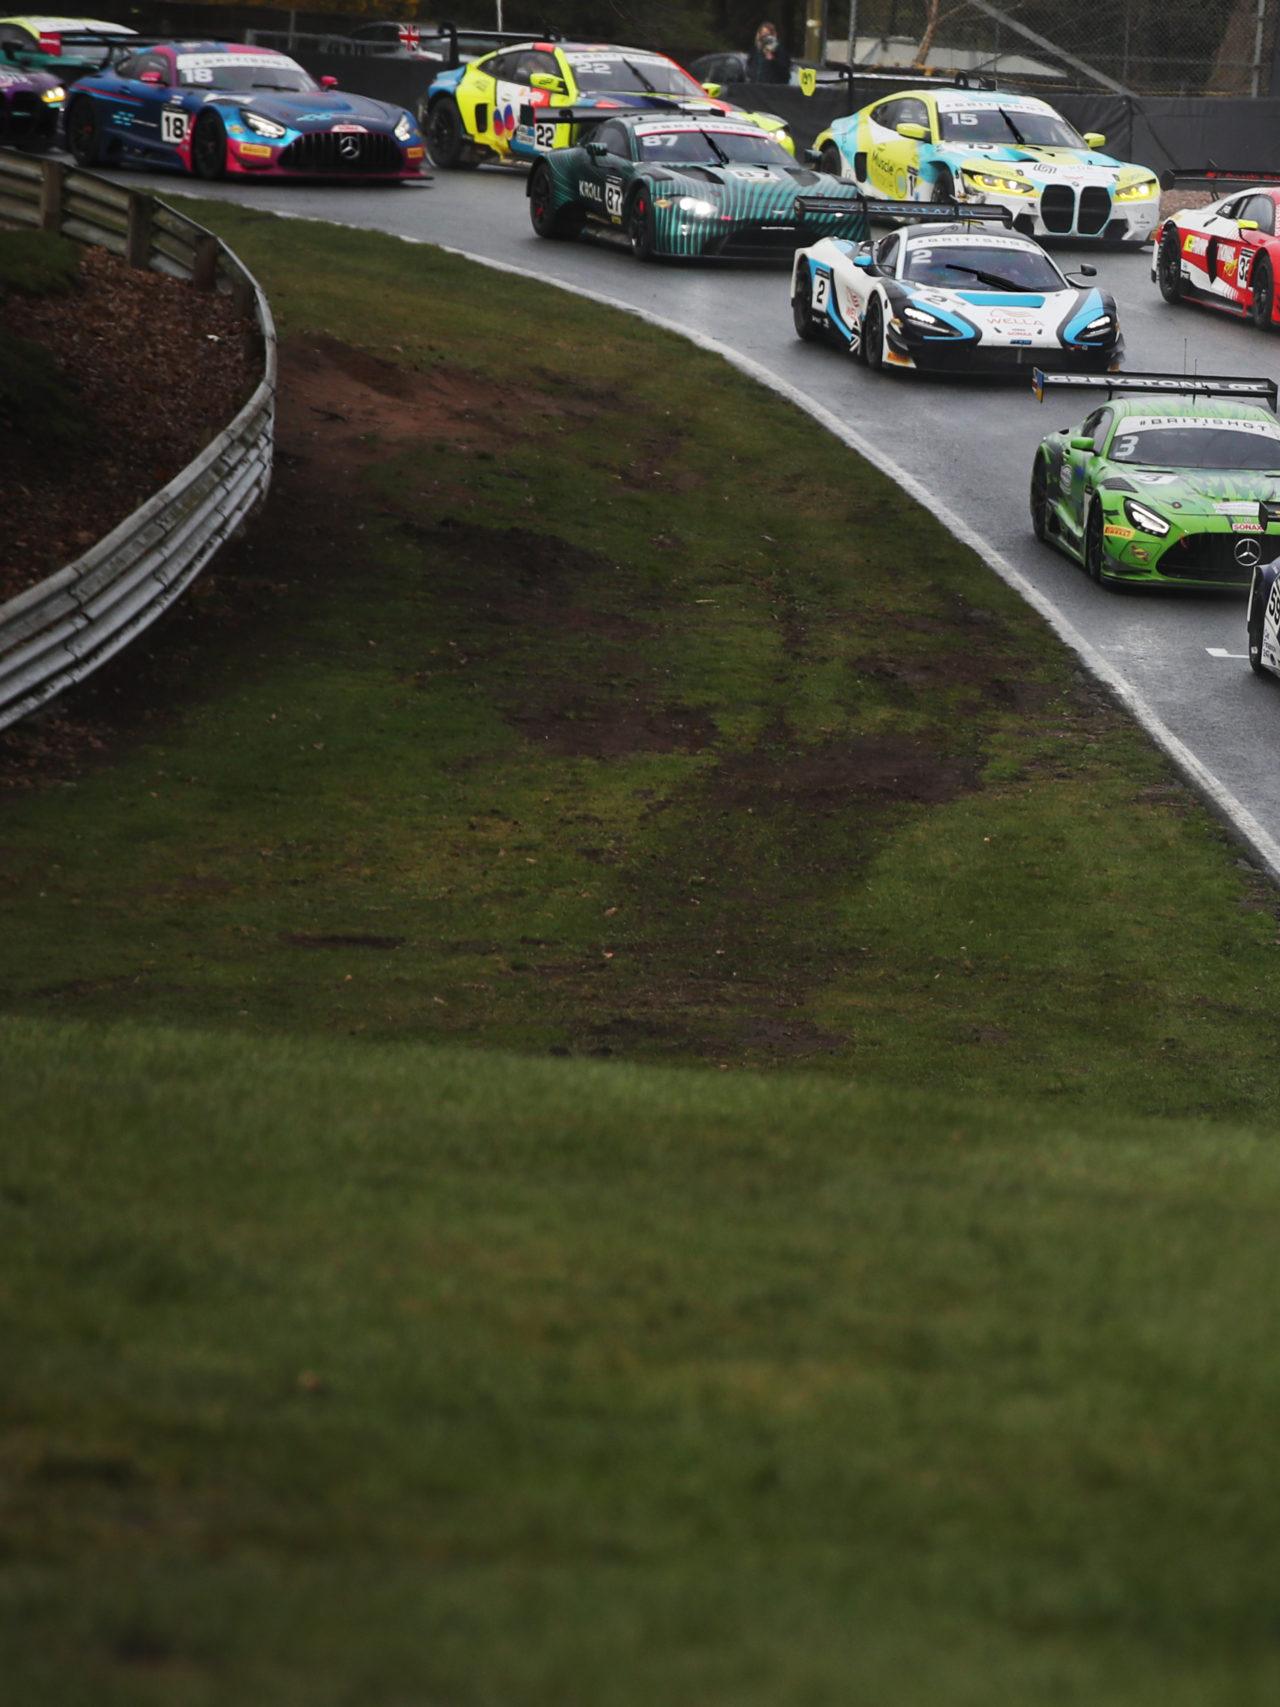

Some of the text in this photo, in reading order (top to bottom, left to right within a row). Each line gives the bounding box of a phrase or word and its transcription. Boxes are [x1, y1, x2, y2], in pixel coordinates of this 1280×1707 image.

[182, 68, 213, 83] 18
[576, 62, 612, 75] 22
[948, 113, 978, 126] 15
[164, 116, 185, 139] 18
[536, 126, 554, 147] 22
[641, 135, 678, 147] 87
[578, 179, 603, 202] KROLL
[606, 185, 622, 216] 87
[911, 250, 932, 264] 2
[816, 279, 826, 304] 2
[986, 317, 1046, 326] WELLA
[1046, 375, 1269, 391] GREYSTONE GT
[1139, 418, 1267, 431] #BRITISHGT
[1114, 435, 1139, 458] 3
[1104, 526, 1133, 538] PIRELLI
[1232, 523, 1265, 531] SONAX
